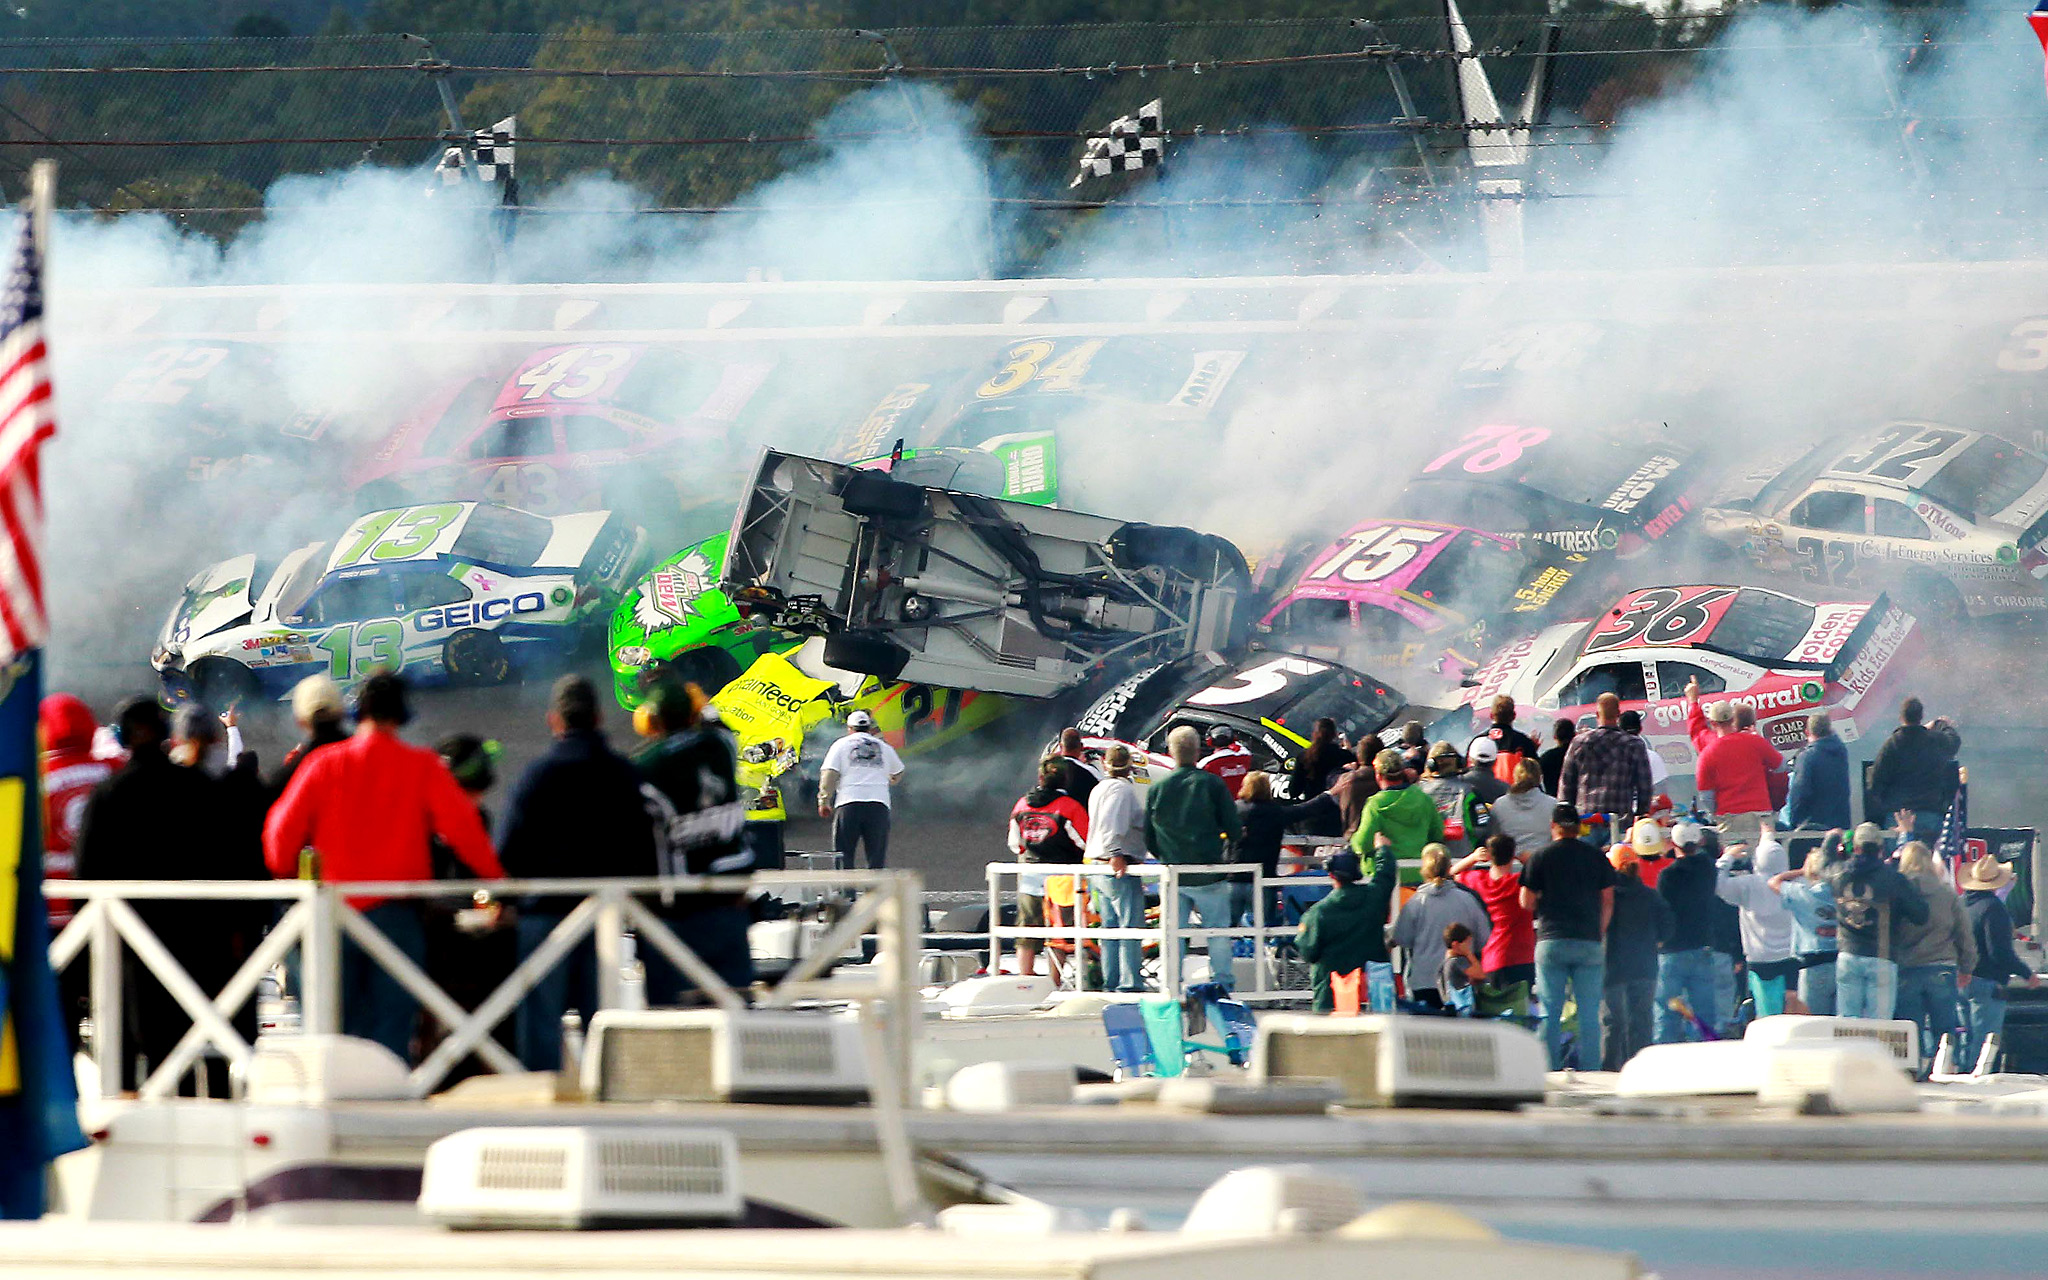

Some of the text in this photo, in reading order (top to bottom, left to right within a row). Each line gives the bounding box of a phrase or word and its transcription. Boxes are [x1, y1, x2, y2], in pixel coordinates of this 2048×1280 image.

[518, 348, 632, 399] 43
[976, 337, 1109, 398] 34
[1422, 424, 1551, 473] 78
[1830, 424, 1967, 481] 32
[484, 465, 559, 510] 43
[1601, 455, 1668, 508] URNITURE
[1614, 457, 1680, 514] ROW
[335, 503, 466, 567] 13
[1309, 525, 1446, 582] 15
[1898, 544, 1938, 562] Energy
[1942, 547, 1994, 564] Services
[1532, 568, 1574, 605] ENERGY
[1796, 536, 1860, 590] 32
[413, 591, 546, 633] GEICO
[1584, 588, 1740, 652] 36
[242, 638, 261, 650] 3M
[316, 618, 404, 680] 13
[1185, 656, 1331, 706] 5
[1770, 731, 1808, 747] CORRA
[1772, 719, 1804, 736] CAMP
